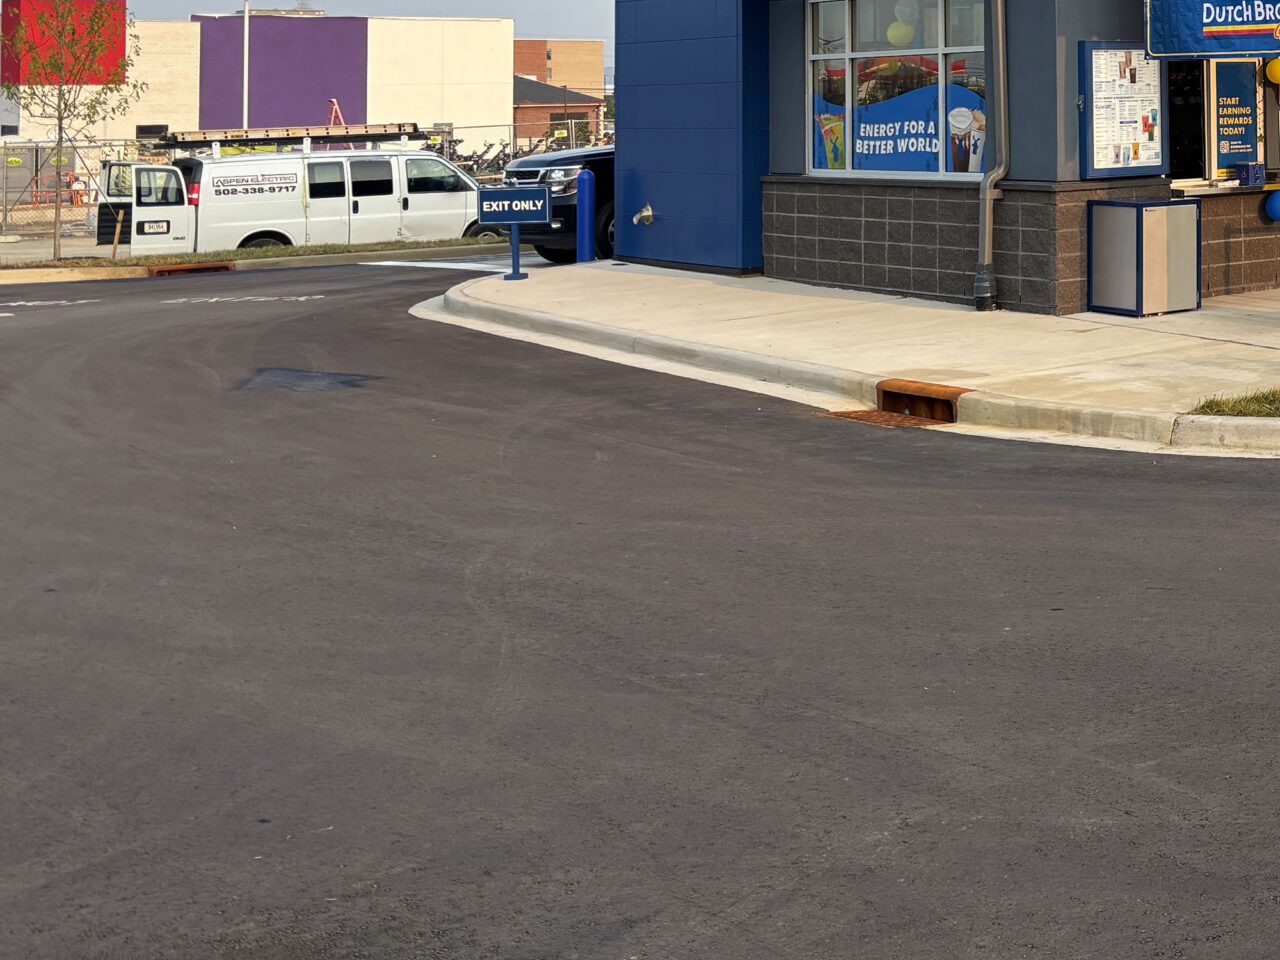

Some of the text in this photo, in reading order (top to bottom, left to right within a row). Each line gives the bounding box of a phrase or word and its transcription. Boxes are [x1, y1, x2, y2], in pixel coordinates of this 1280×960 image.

[1203, 0, 1252, 24] DUTCH
[1219, 97, 1239, 106] START
[1219, 107, 1251, 115] EARNING
[1219, 117, 1252, 125] REWARDS
[860, 121, 935, 137] ENERGY FOR A
[1220, 127, 1245, 136] TODAY!
[856, 138, 940, 154] BETTER WORLD
[215, 175, 295, 186] ASPEN ELECTRIC
[214, 186, 296, 196] 502-338-9717
[483, 200, 543, 211] EXIT ONLY
